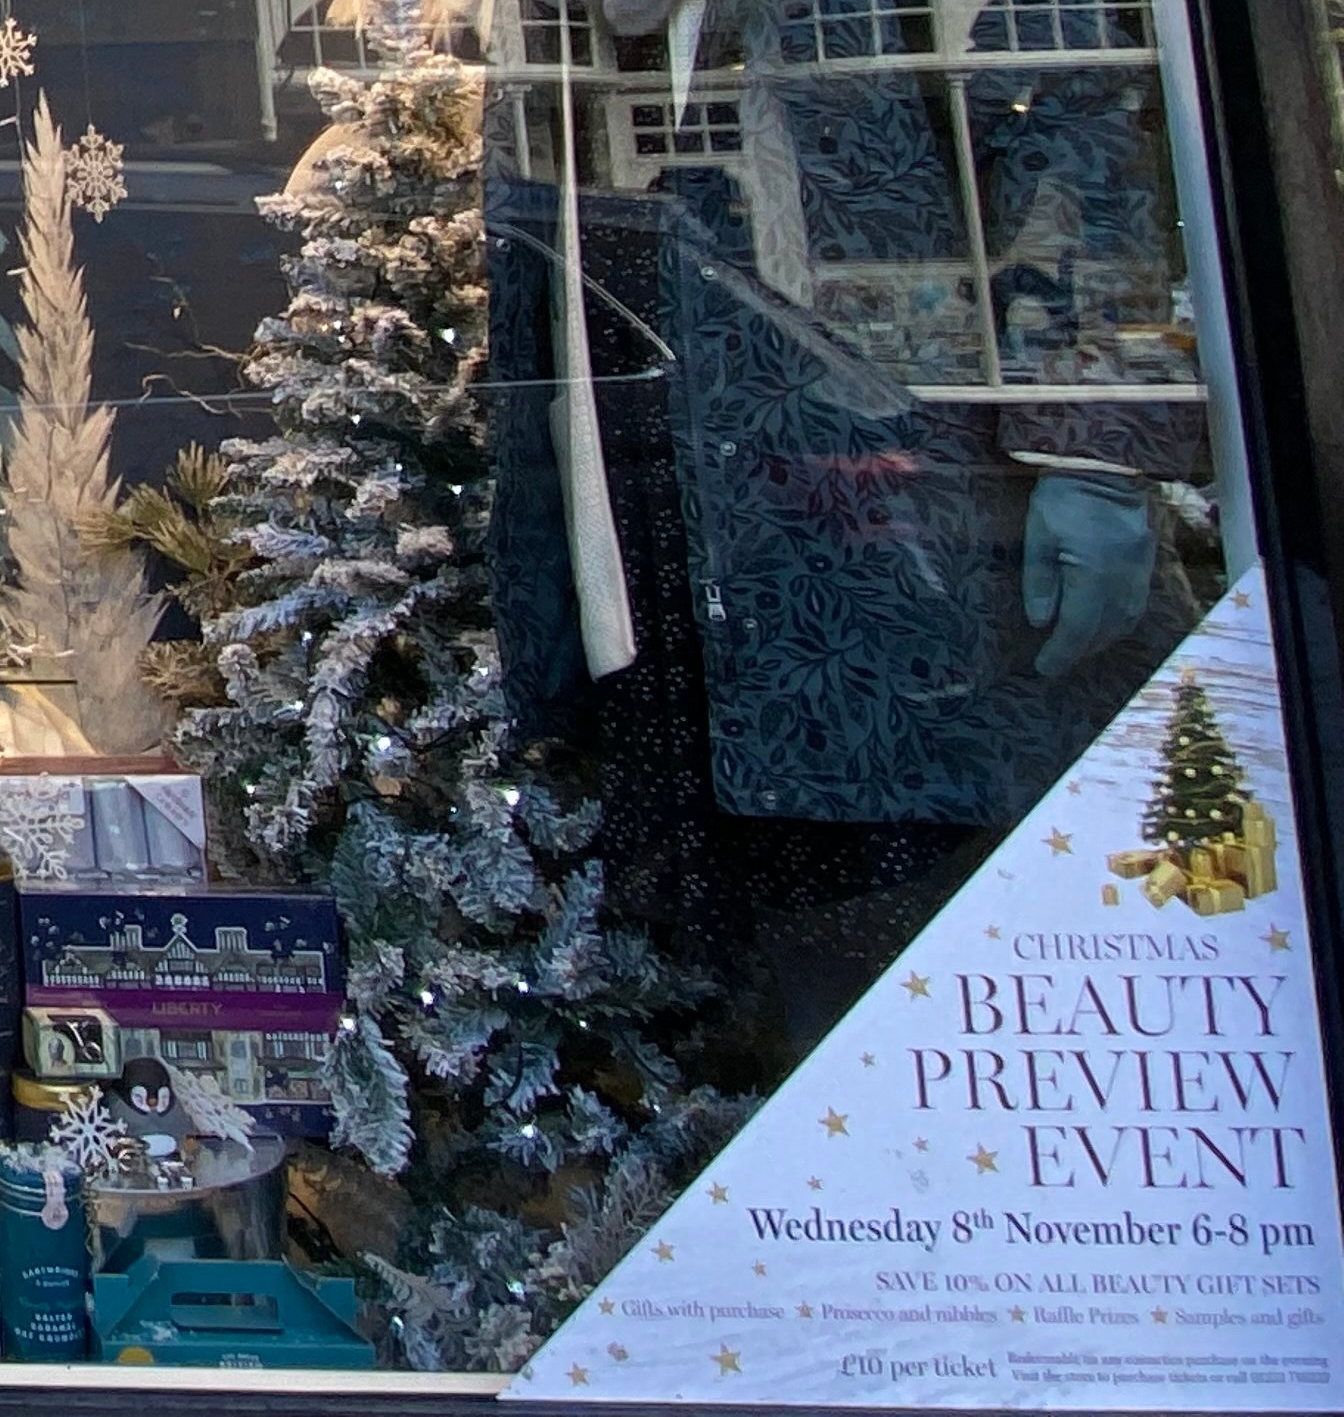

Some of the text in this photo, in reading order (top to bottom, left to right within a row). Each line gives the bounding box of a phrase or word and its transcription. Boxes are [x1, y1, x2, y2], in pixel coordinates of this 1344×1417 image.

[1013, 933, 1220, 961] CHRISTMAS
[153, 1001, 223, 1016] LIBERTY
[954, 973, 1288, 1037] BEAUTY
[908, 1048, 1296, 1113] PREVIEW
[1021, 1125, 1306, 1189] EVENT
[746, 1207, 1315, 1255] Wednesday 8th November 6-8 pm
[876, 1271, 1321, 1294] SAVE 10% ON ALL BEAUTY GIFT SETS
[621, 1299, 785, 1323] Gifts with purchase
[822, 1303, 998, 1324] Prosecco and nibbles
[1034, 1306, 1139, 1325] Raffle Prizes
[1175, 1307, 1325, 1330] Samples and gifts
[841, 1353, 997, 1381] £10 per ticket
